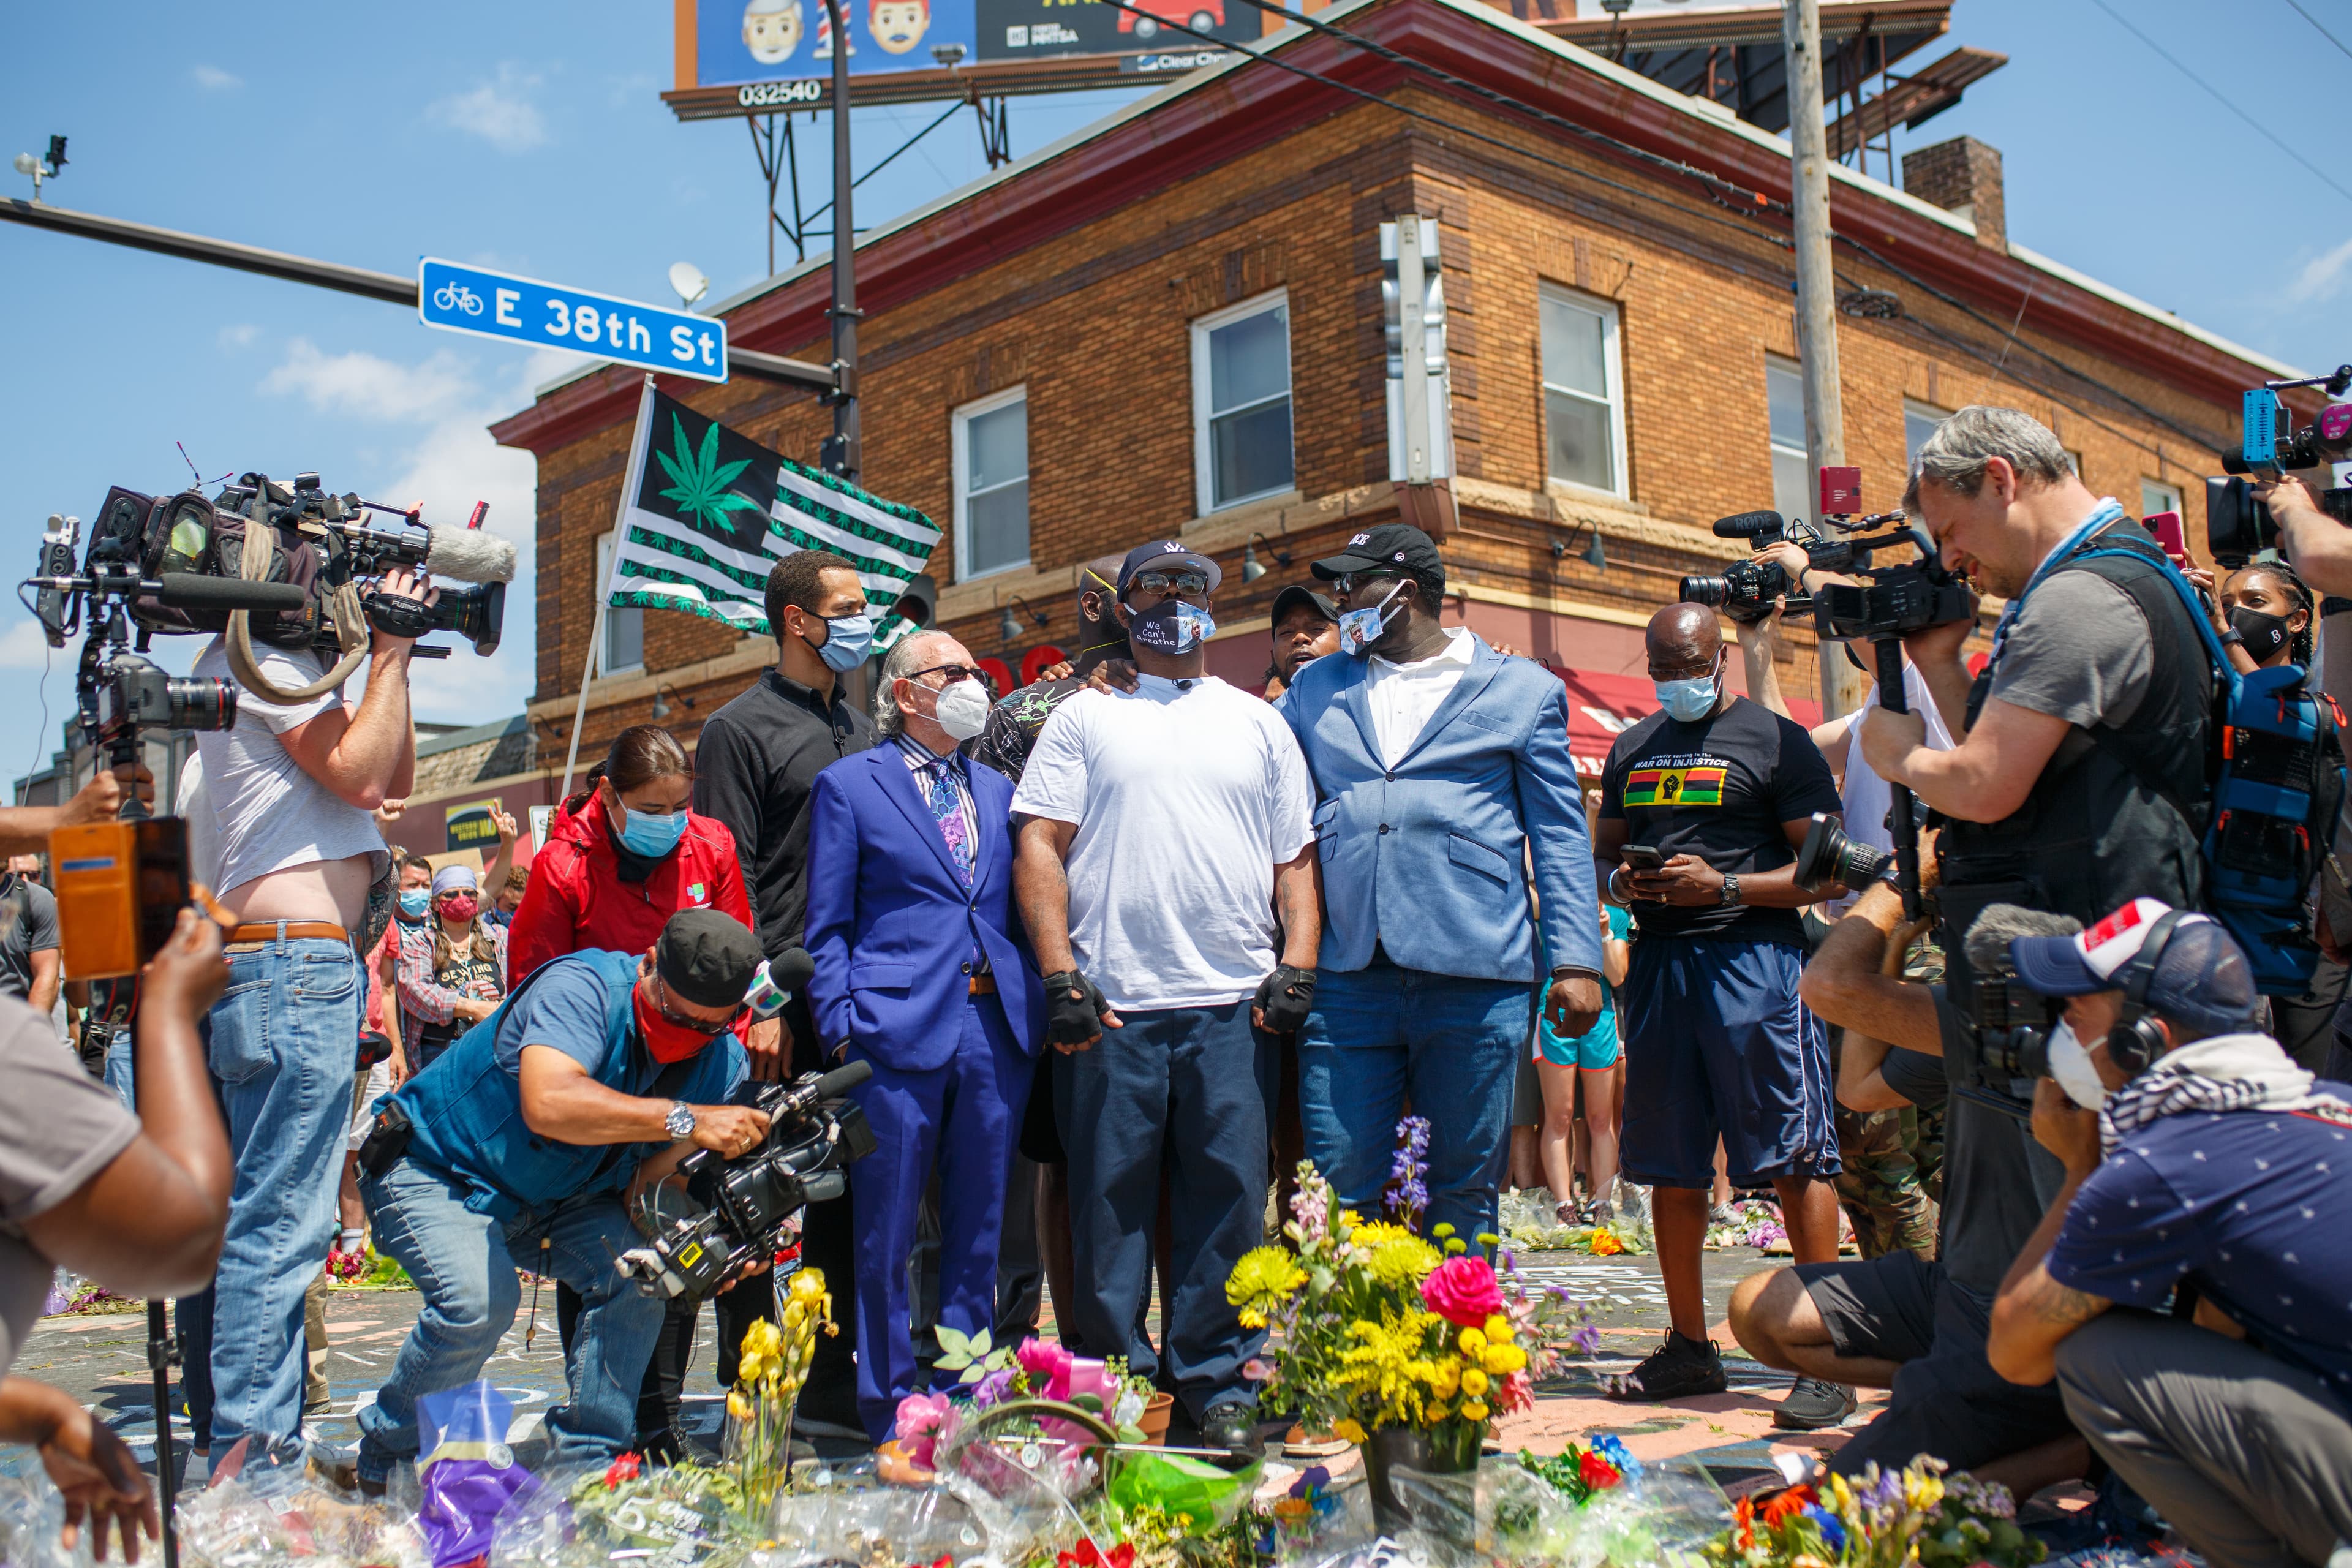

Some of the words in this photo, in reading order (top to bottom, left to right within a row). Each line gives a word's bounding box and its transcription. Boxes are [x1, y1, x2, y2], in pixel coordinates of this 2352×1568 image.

[739, 79, 821, 107] 032540
[496, 288, 522, 328] E
[545, 299, 650, 354] 38th
[670, 326, 715, 366] St
[1146, 621, 1161, 630] We
[1142, 629, 1166, 638] Can't
[1673, 758, 1730, 767] INJUSTICE
